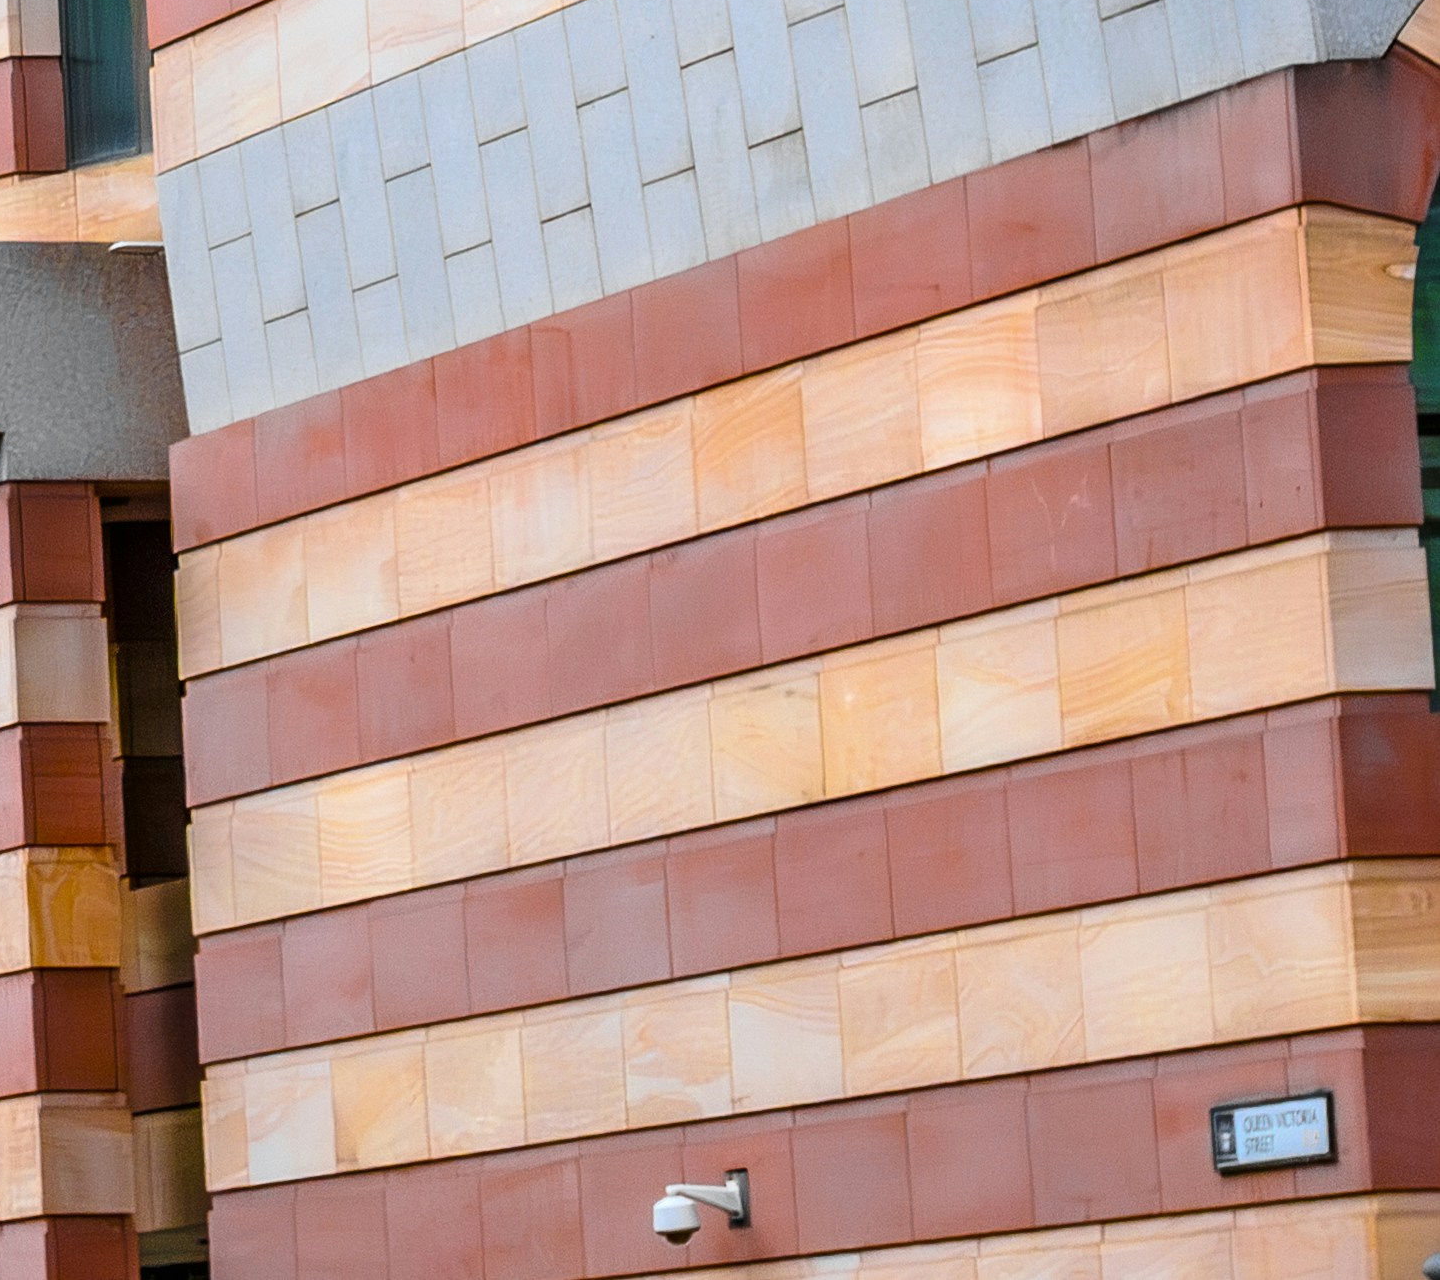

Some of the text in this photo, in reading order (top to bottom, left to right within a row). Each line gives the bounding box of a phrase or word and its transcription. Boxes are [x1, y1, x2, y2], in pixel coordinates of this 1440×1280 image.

[1244, 1108, 1319, 1133] QUEEN VICTORIA
[1244, 1134, 1275, 1154] STREET
